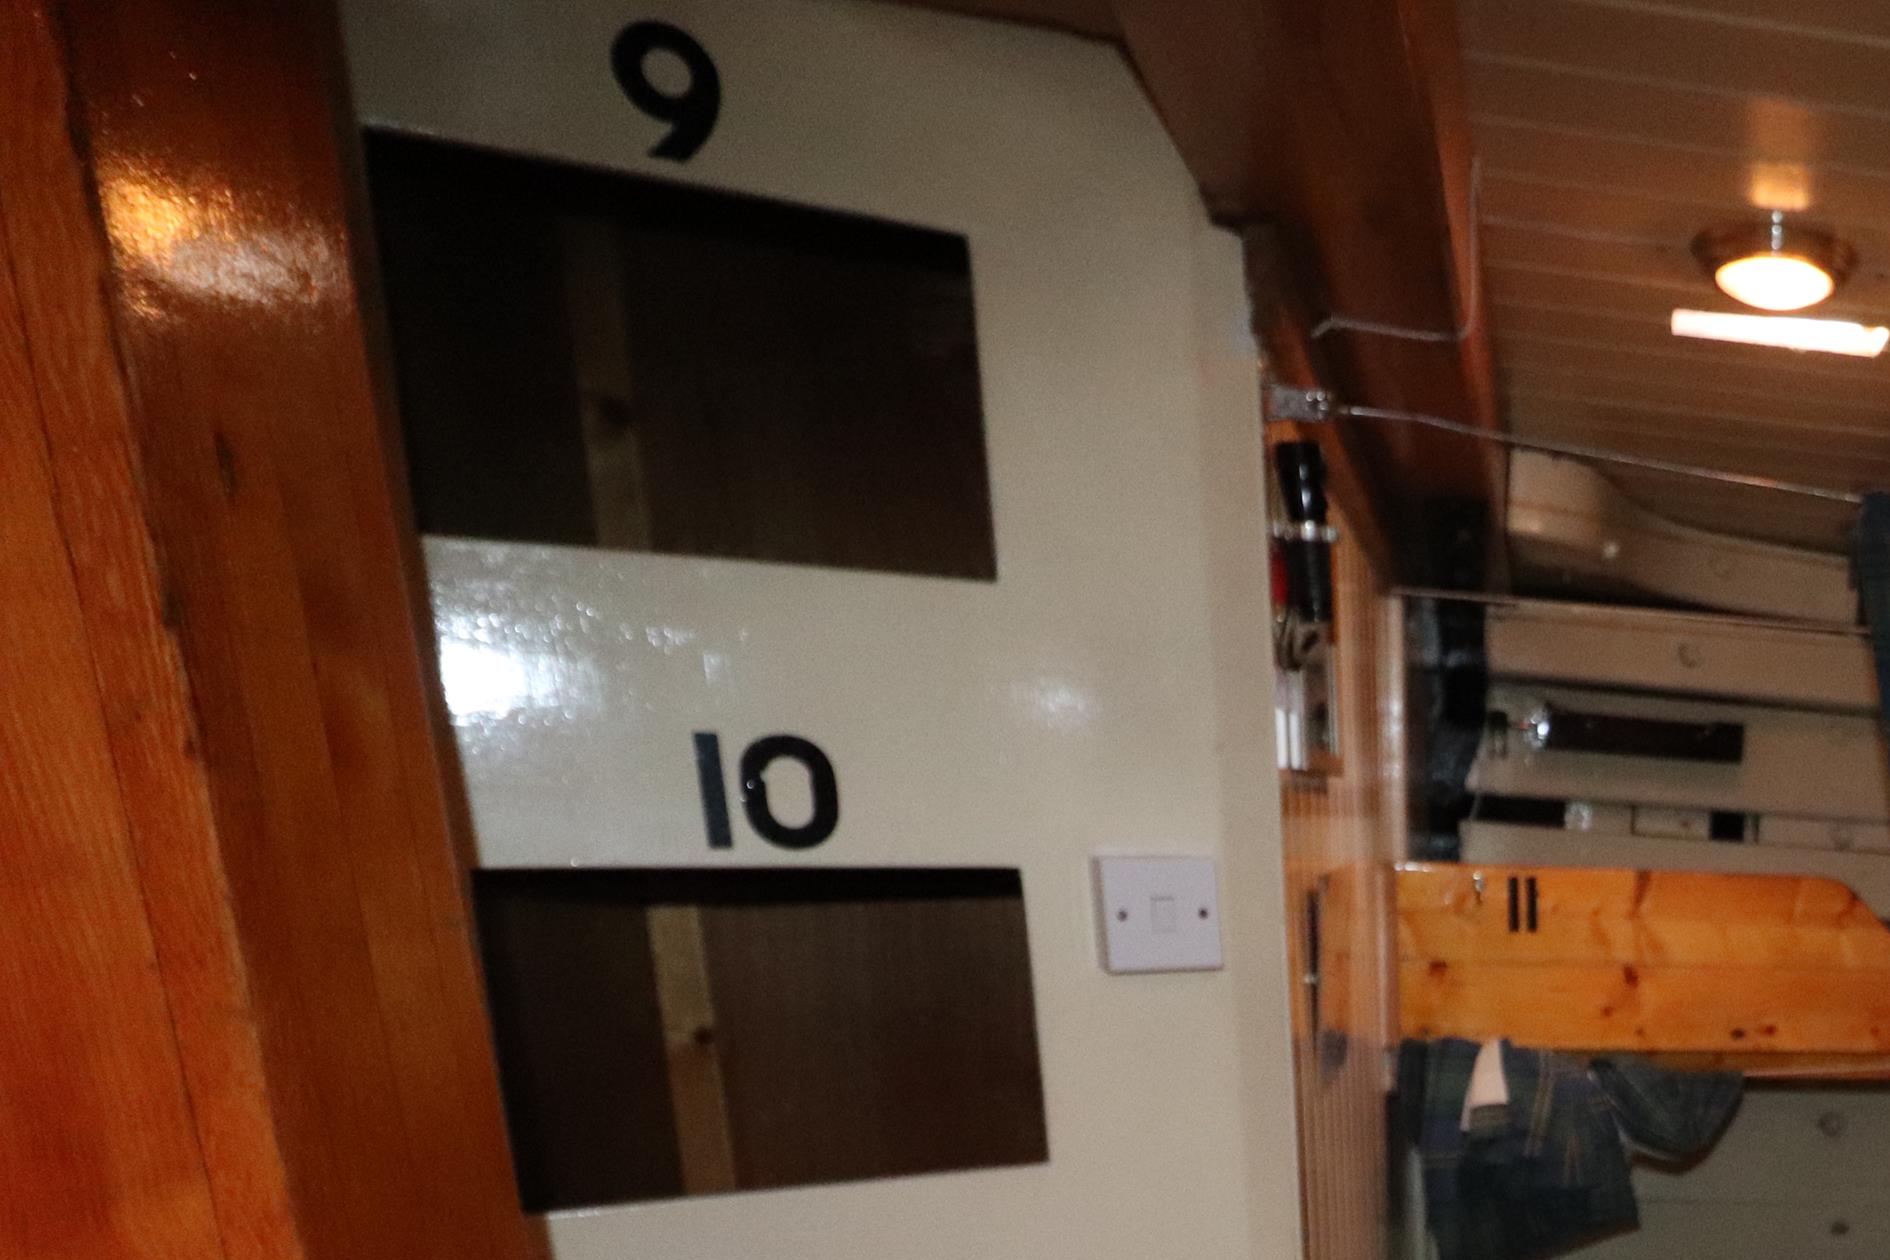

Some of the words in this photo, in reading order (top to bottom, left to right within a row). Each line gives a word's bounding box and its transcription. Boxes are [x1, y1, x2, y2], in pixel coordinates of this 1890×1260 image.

[610, 20, 721, 156] 9
[694, 733, 839, 850] 10
[1508, 876, 1539, 933] 11
